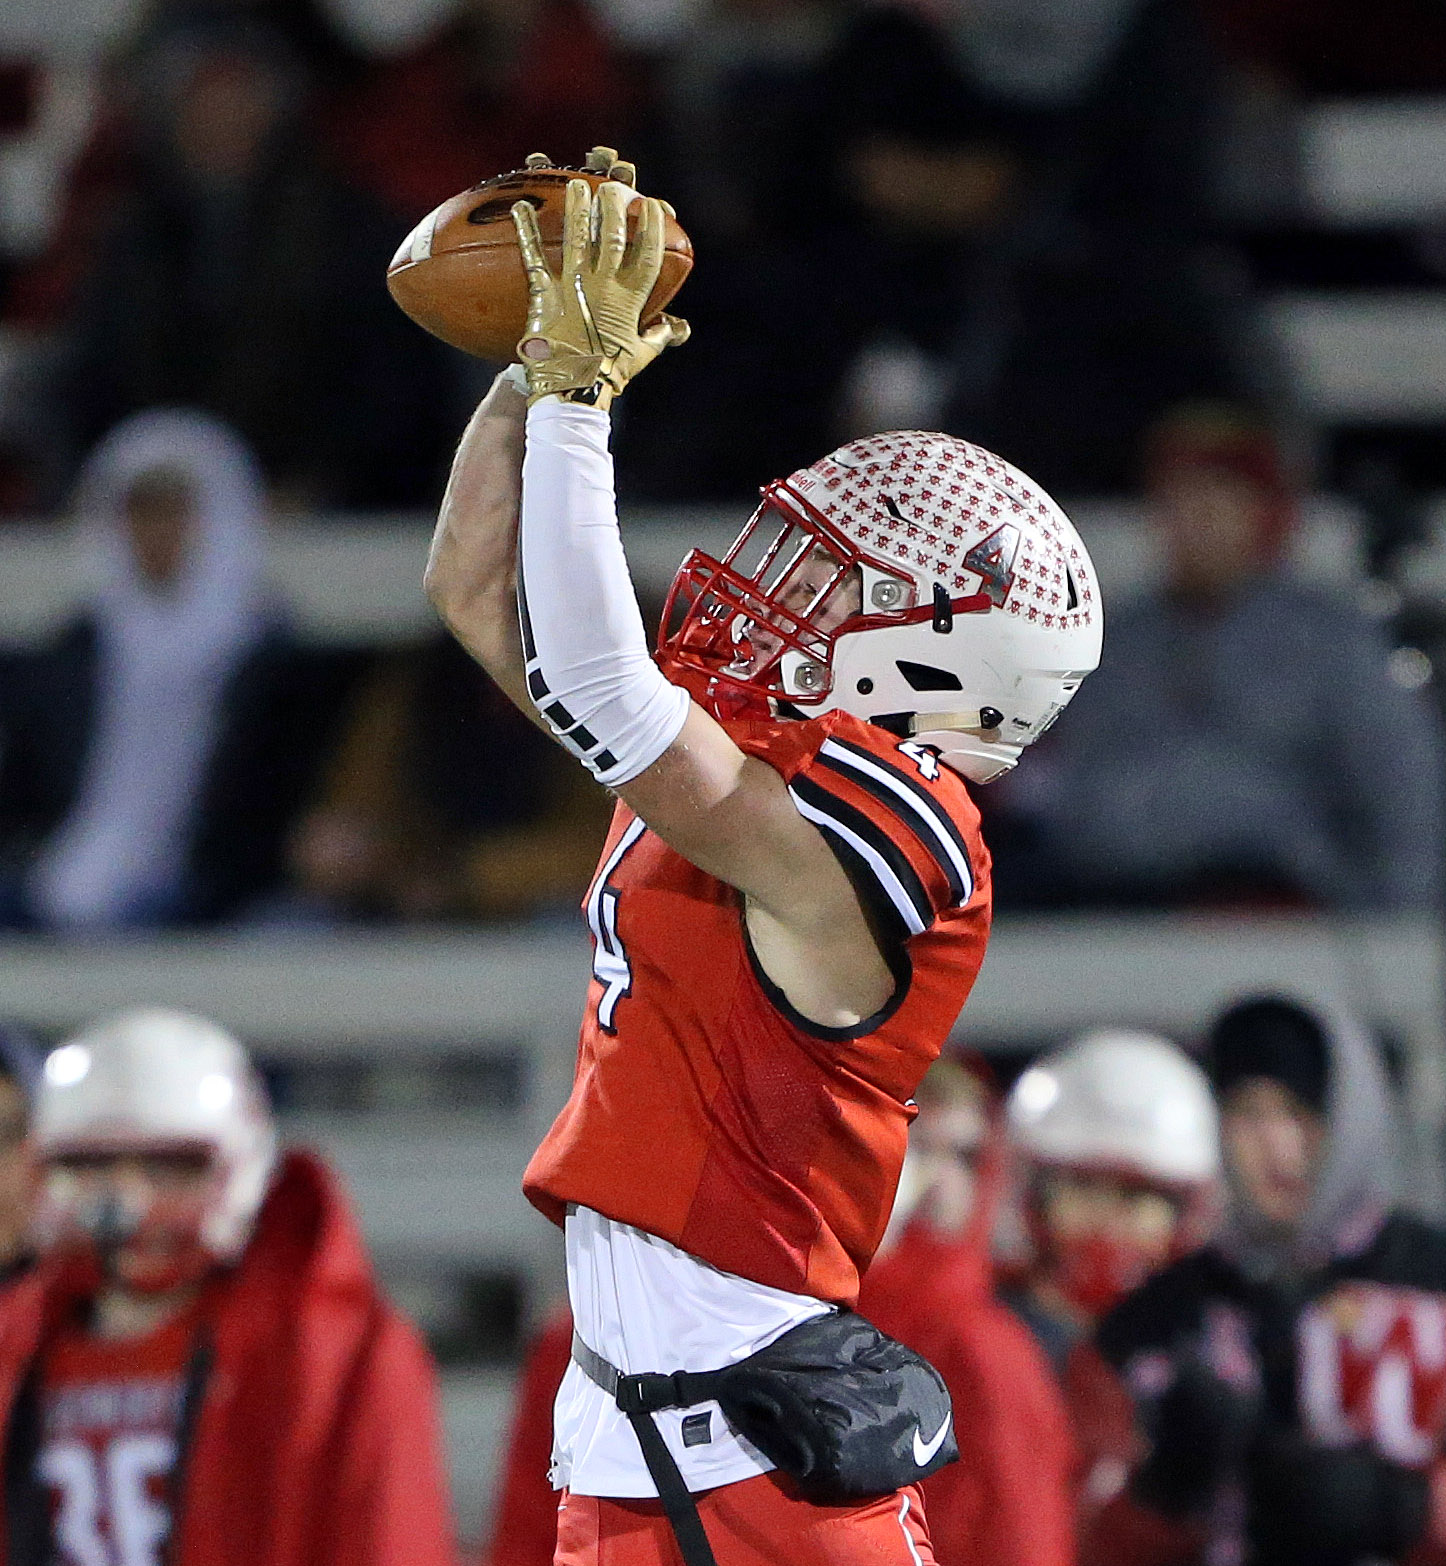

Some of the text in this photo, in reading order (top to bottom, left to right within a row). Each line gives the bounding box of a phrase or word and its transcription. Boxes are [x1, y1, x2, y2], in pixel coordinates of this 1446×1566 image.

[962, 522, 1020, 609] 4
[896, 741, 942, 781] 4
[587, 815, 648, 1036] 4
